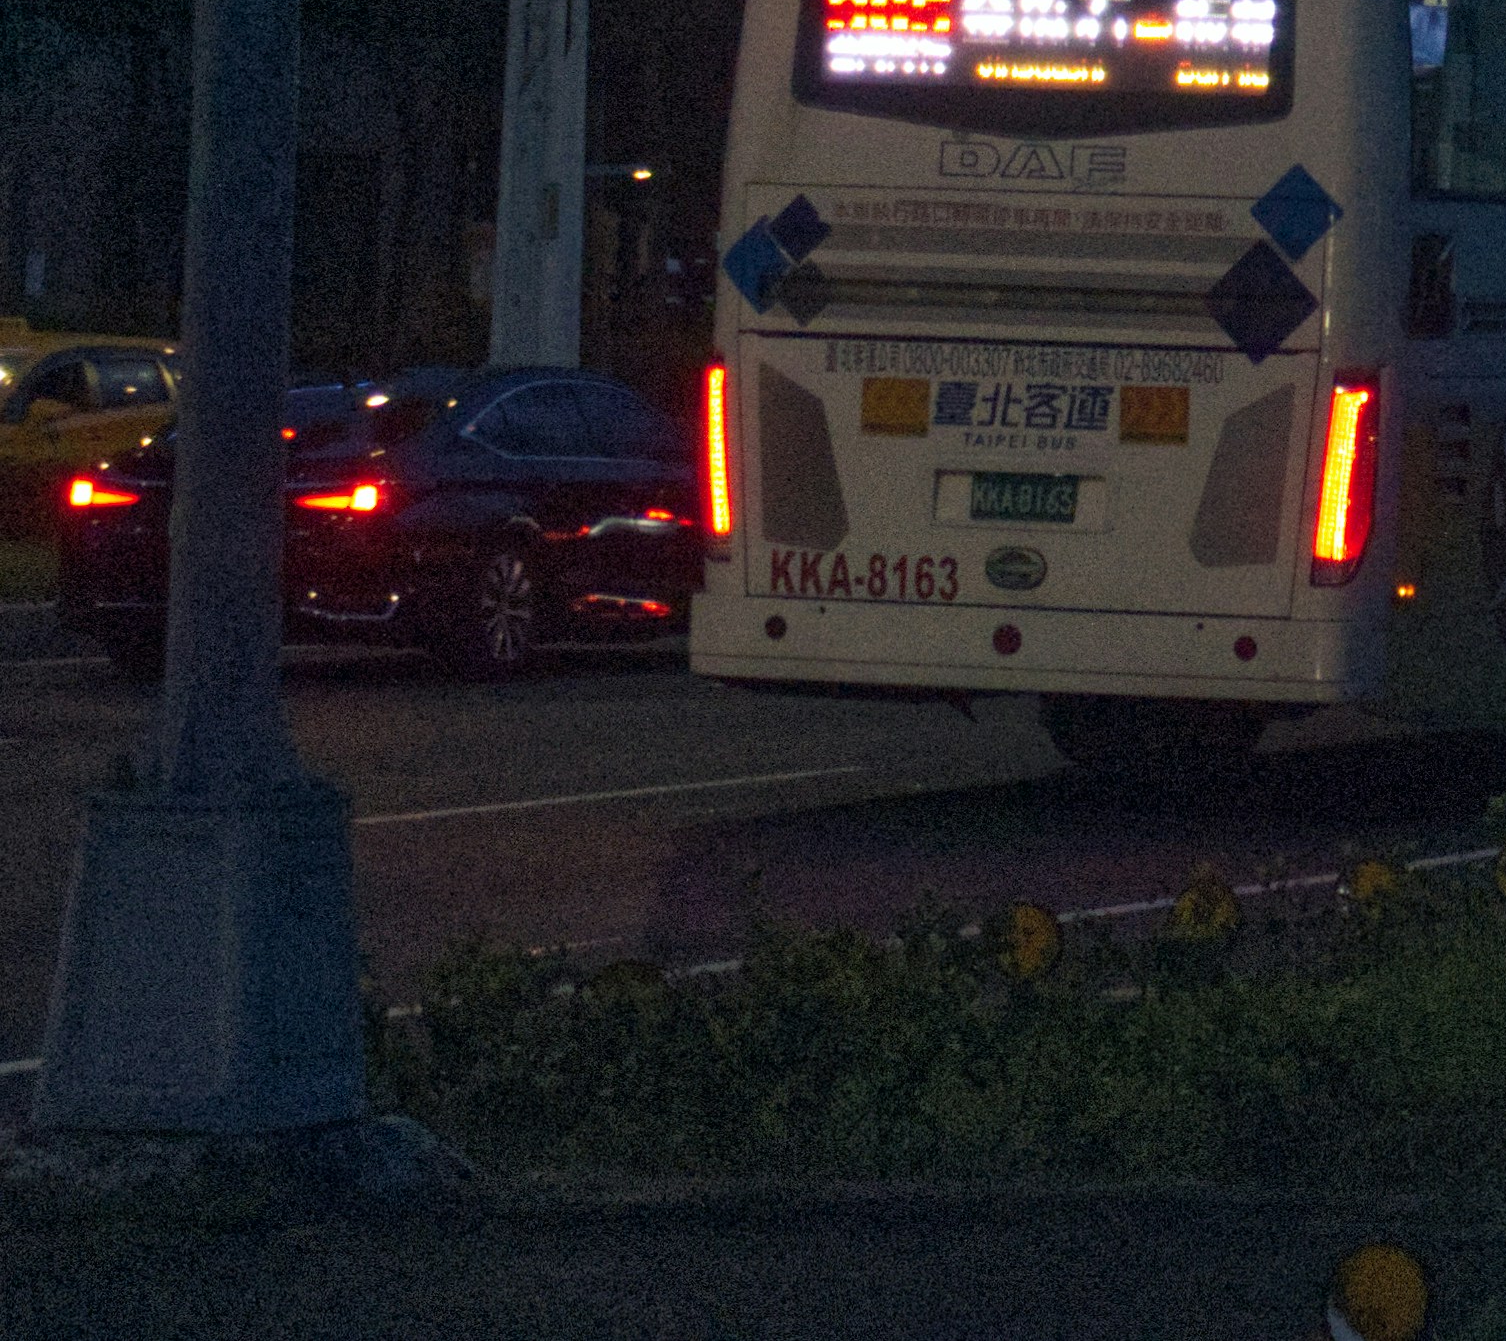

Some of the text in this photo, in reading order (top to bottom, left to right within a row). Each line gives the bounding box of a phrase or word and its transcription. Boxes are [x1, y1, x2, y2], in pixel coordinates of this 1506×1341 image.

[939, 140, 1127, 180] DAF
[903, 343, 1010, 377] 0800-003307
[1114, 349, 1224, 383] 02-89682460
[933, 380, 1115, 431] 臺北客運
[963, 432, 1078, 451] TAIPEI BUS
[770, 549, 959, 602] KKA-8163
